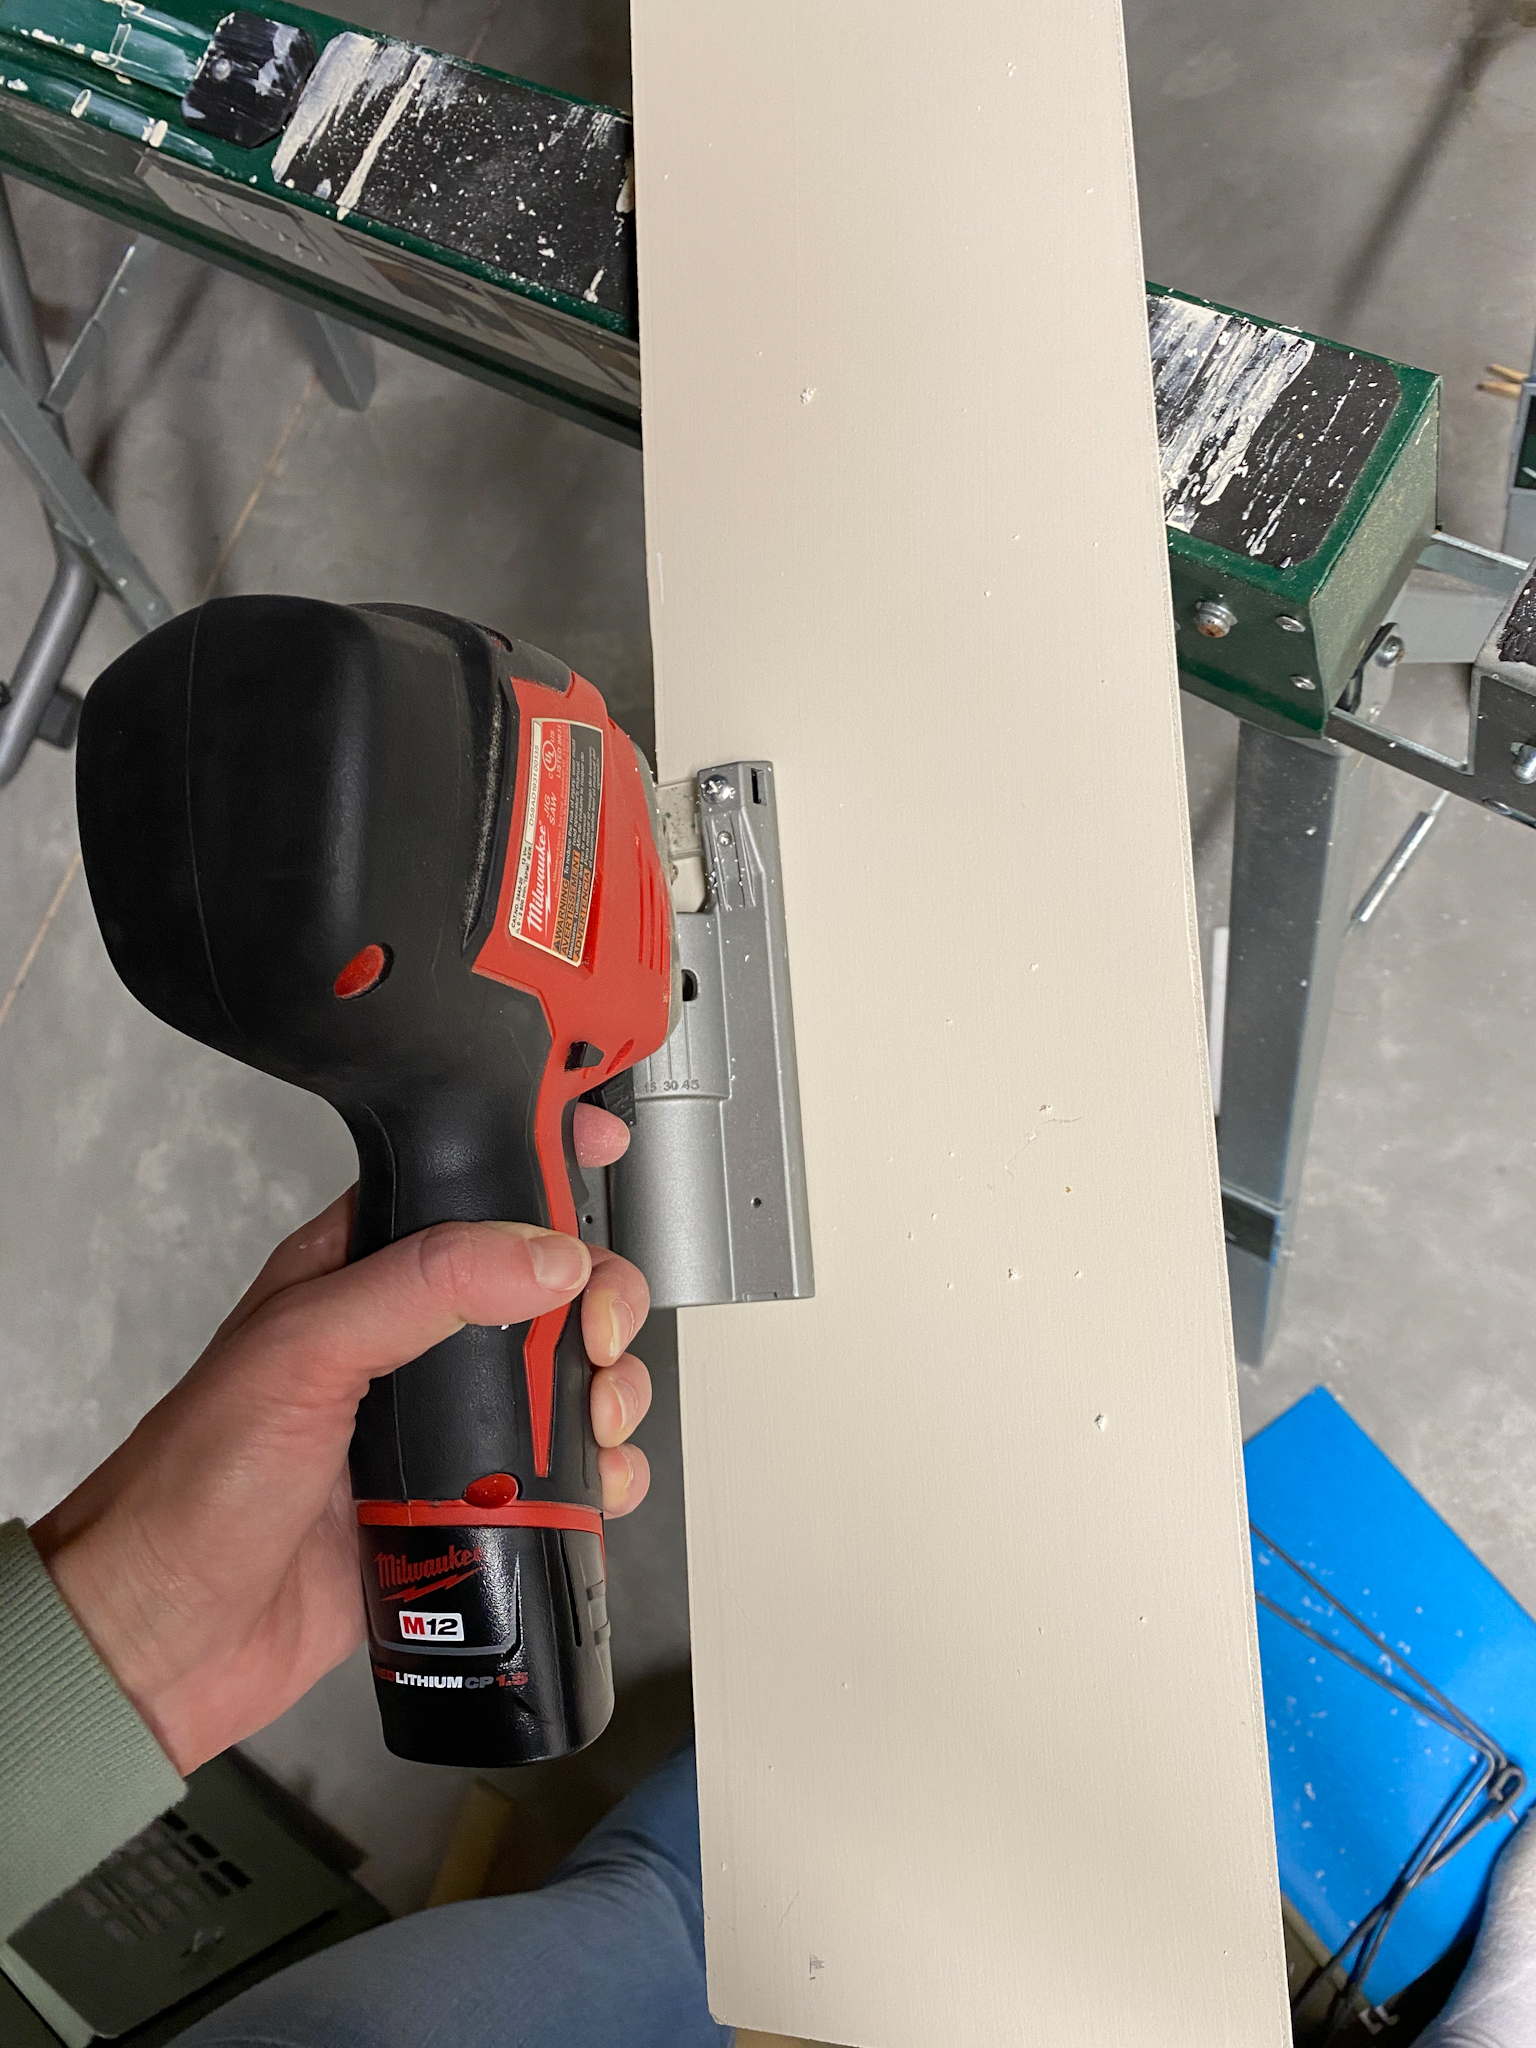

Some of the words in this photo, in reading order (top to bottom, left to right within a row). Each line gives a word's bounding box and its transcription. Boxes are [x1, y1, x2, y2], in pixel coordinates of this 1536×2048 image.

[549, 792, 557, 826] SAW
[527, 824, 545, 932] Milwaukee
[555, 879, 568, 940] WARNING
[561, 851, 579, 955] AVERTISSEMENT
[575, 872, 590, 958] ADVERTENCIA
[645, 1082, 657, 1093] 15
[663, 1080, 679, 1091] 30
[681, 1079, 700, 1090] 45
[402, 1615, 458, 1636] M12
[464, 1676, 494, 1689] CP
[496, 1671, 529, 1688] 1.5
